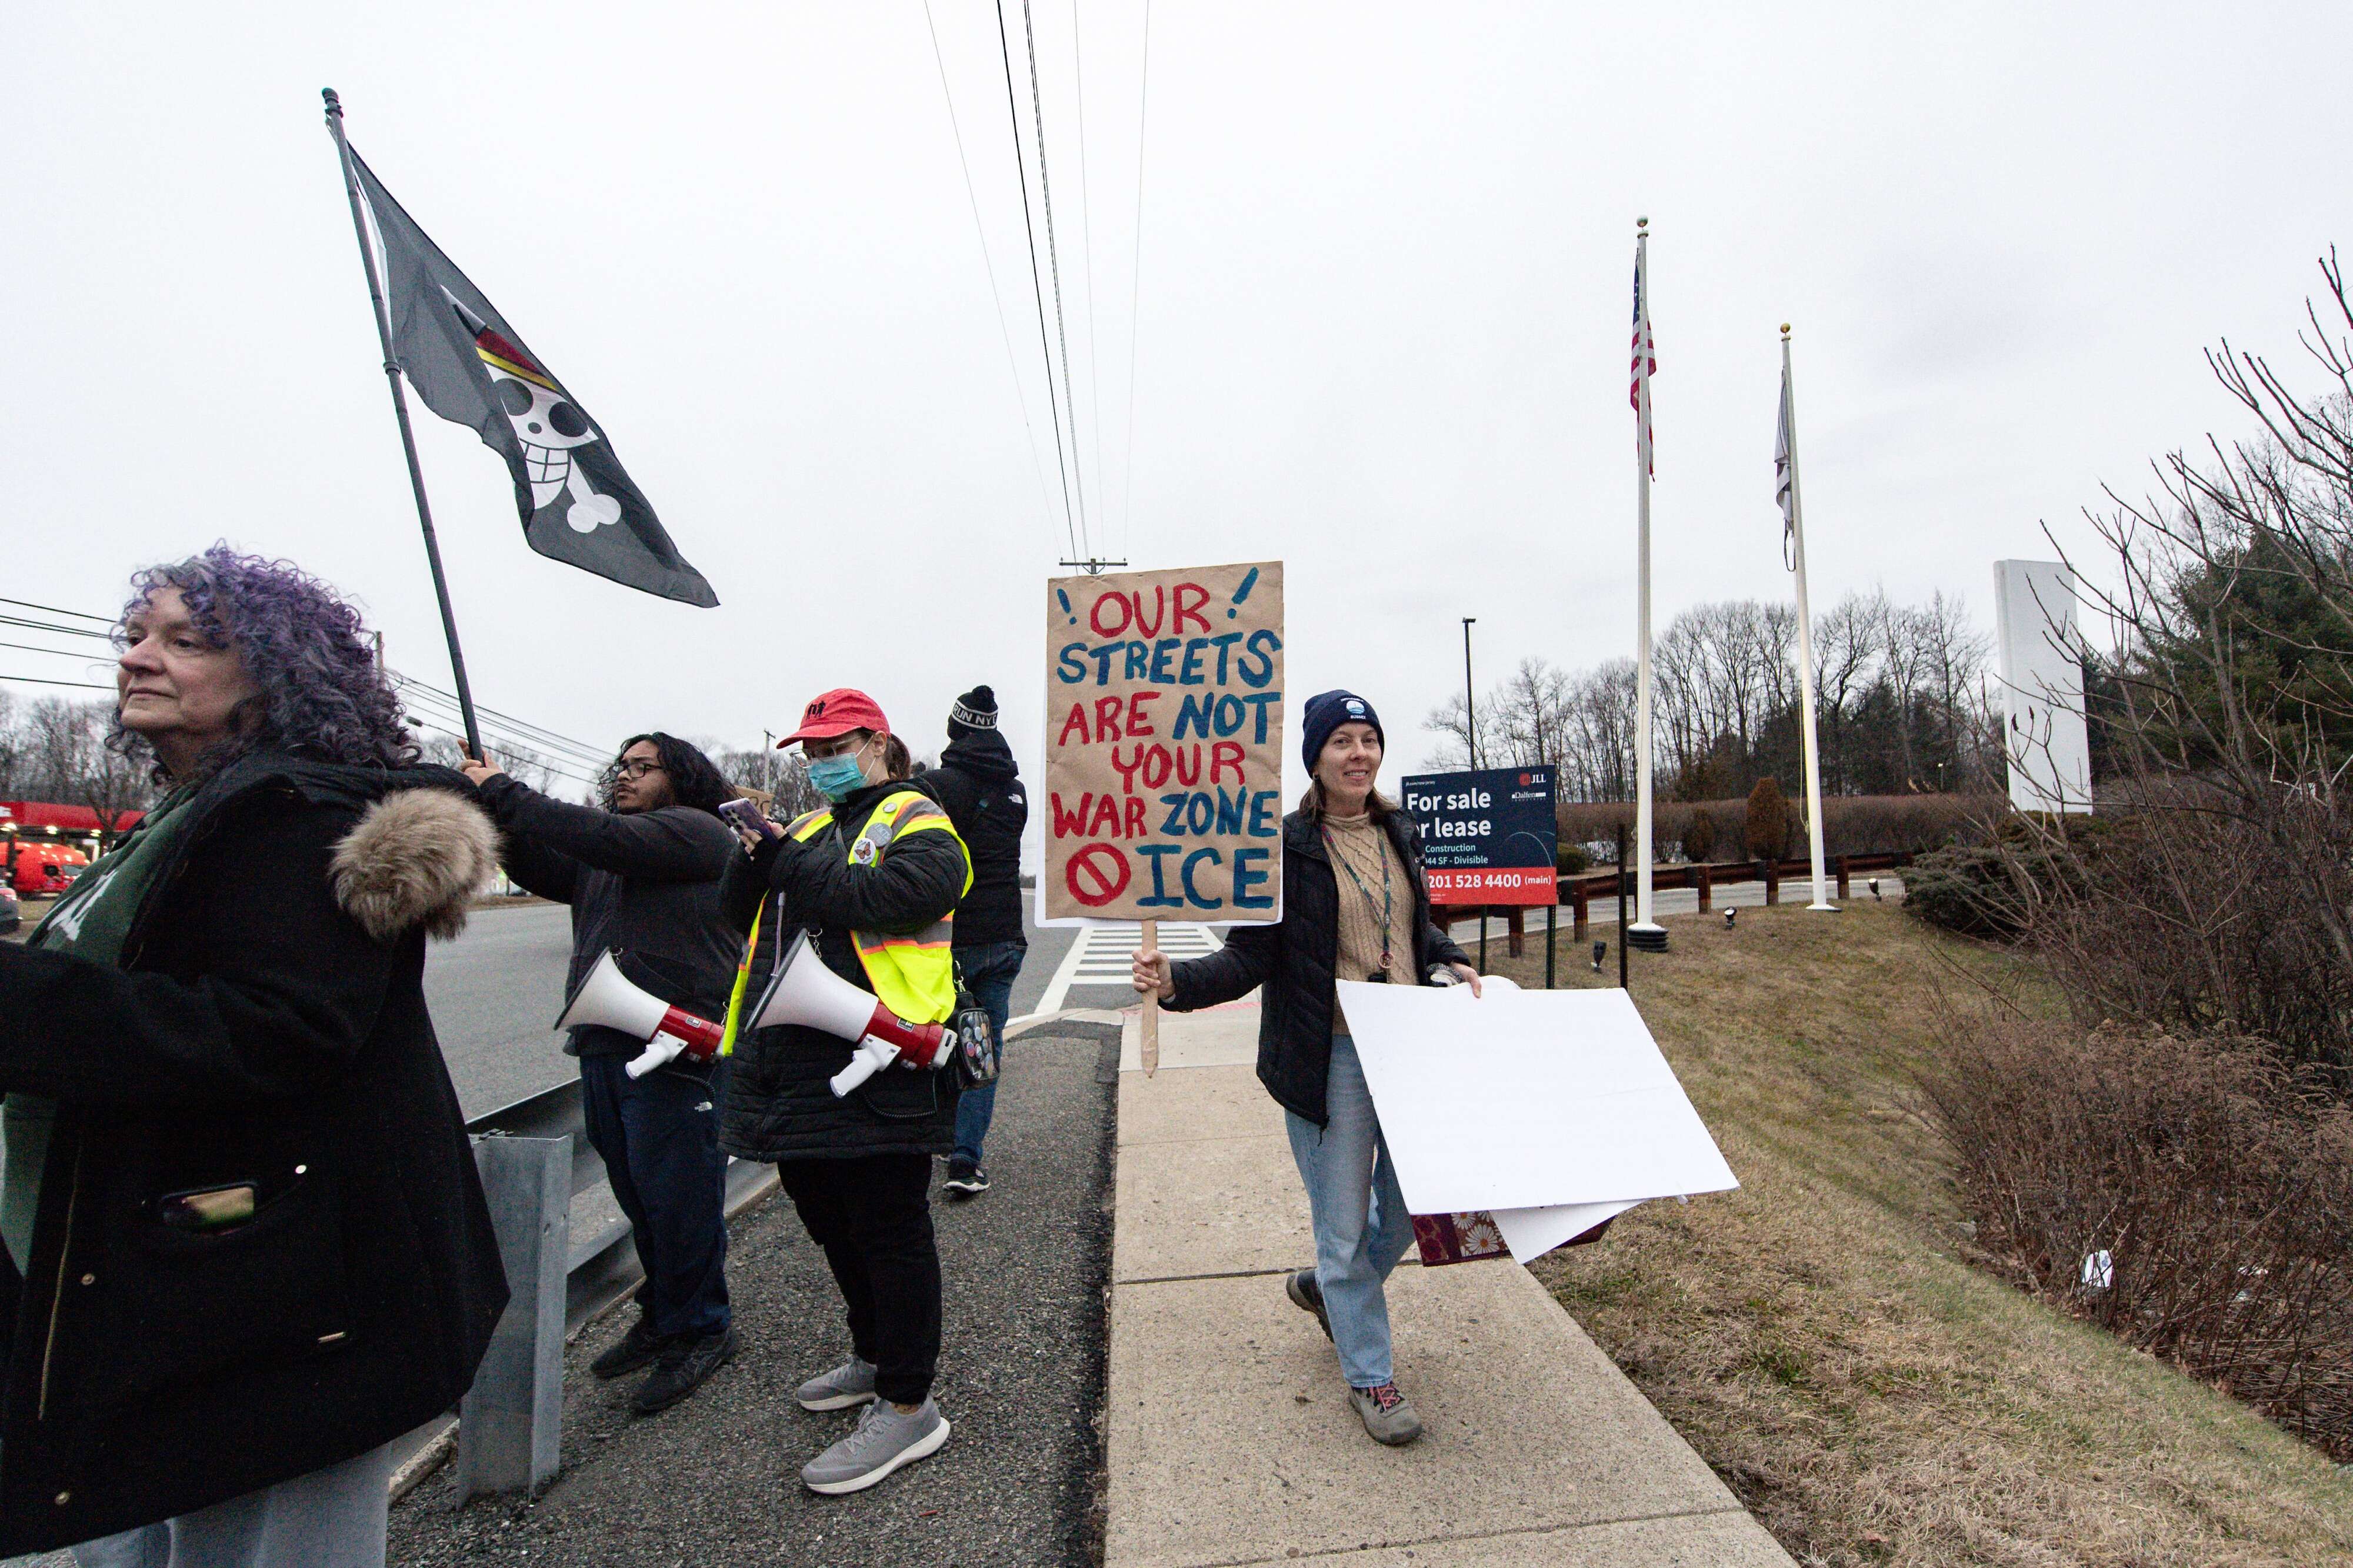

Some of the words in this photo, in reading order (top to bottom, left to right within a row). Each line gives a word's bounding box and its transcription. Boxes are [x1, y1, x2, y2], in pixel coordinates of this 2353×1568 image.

[1090, 583, 1211, 639] OUR
[1057, 629, 1282, 688] STREETS
[953, 703, 973, 722] RUN
[1058, 692, 1162, 746] ARE
[1172, 692, 1281, 745] NOT
[1112, 741, 1245, 795] YOUR
[1531, 774, 1547, 783] JLL
[1407, 793, 1442, 812] For
[1447, 788, 1491, 810] sale
[1051, 792, 1147, 839] WAR
[1159, 786, 1279, 836] ZONE
[1416, 823, 1429, 838] r
[1435, 818, 1491, 838] lease
[1425, 843, 1476, 853] Construction
[1454, 855, 1488, 865] Divisible
[1135, 844, 1275, 909] ICE
[1428, 875, 1452, 888] 201
[1456, 875, 1481, 888] 528
[1485, 874, 1521, 888] 4400
[1525, 875, 1551, 885] (main)
